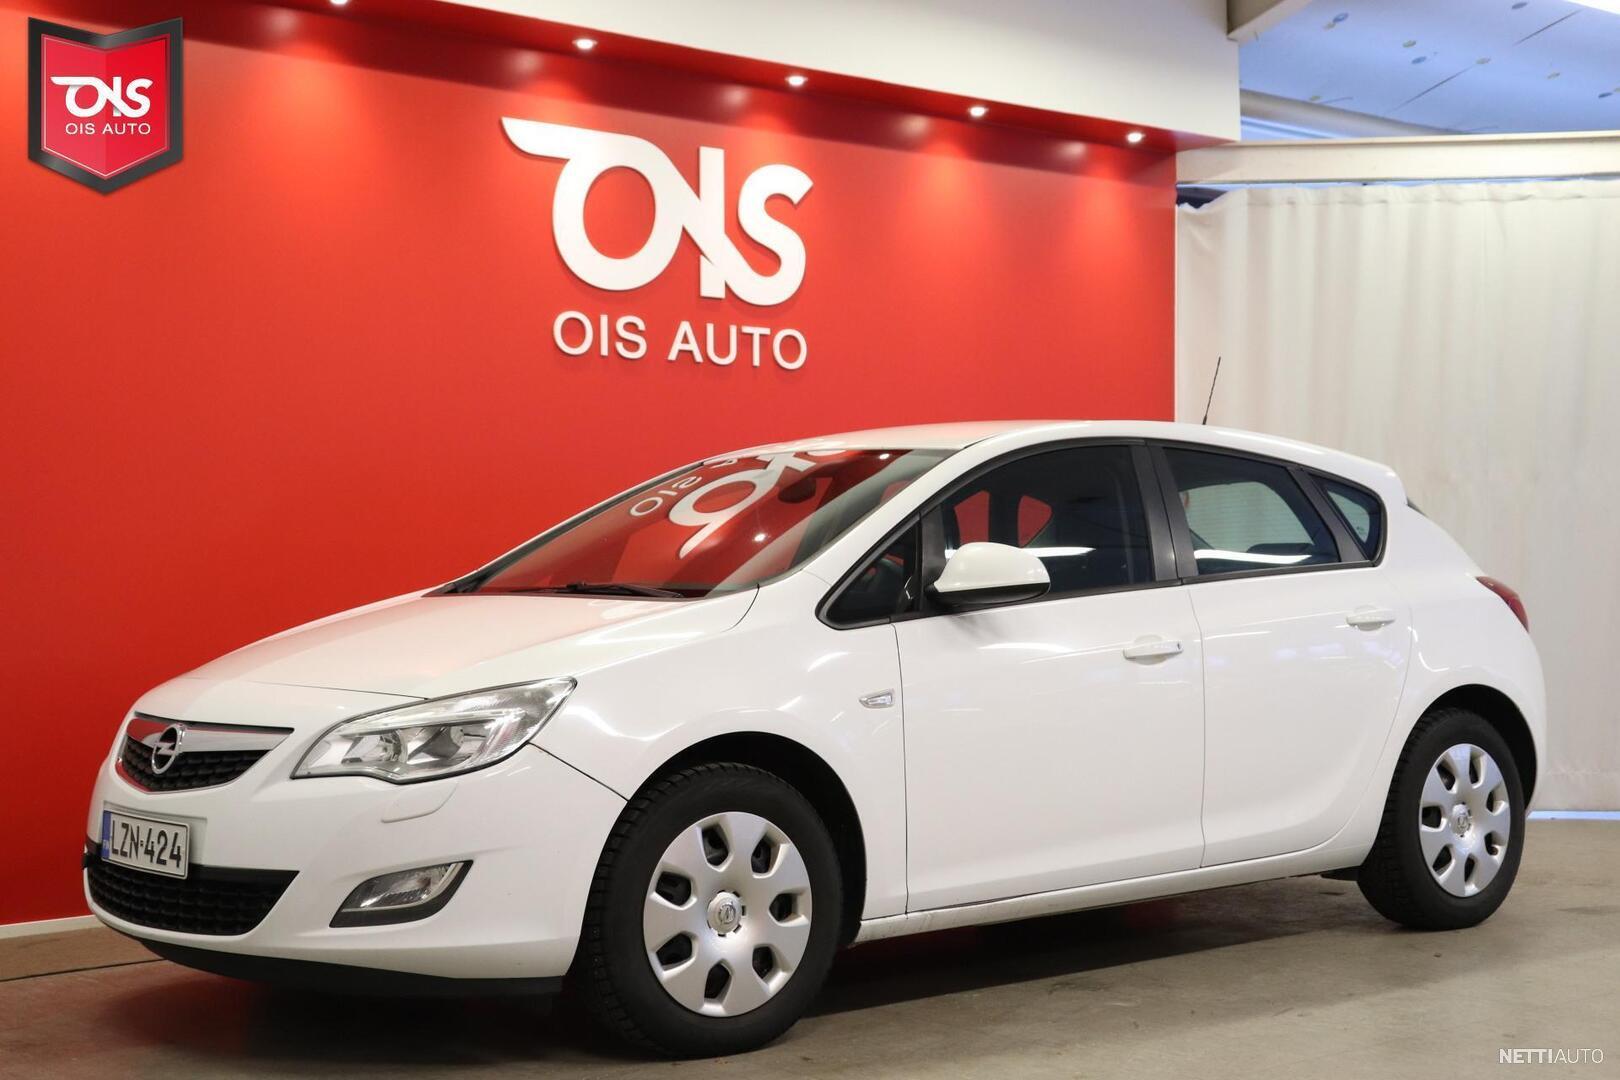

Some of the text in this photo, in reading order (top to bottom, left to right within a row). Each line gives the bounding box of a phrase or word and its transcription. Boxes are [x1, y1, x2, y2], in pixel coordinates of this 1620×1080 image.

[552, 310, 808, 370] OIS AUTO
[111, 819, 181, 868] LZN-424
